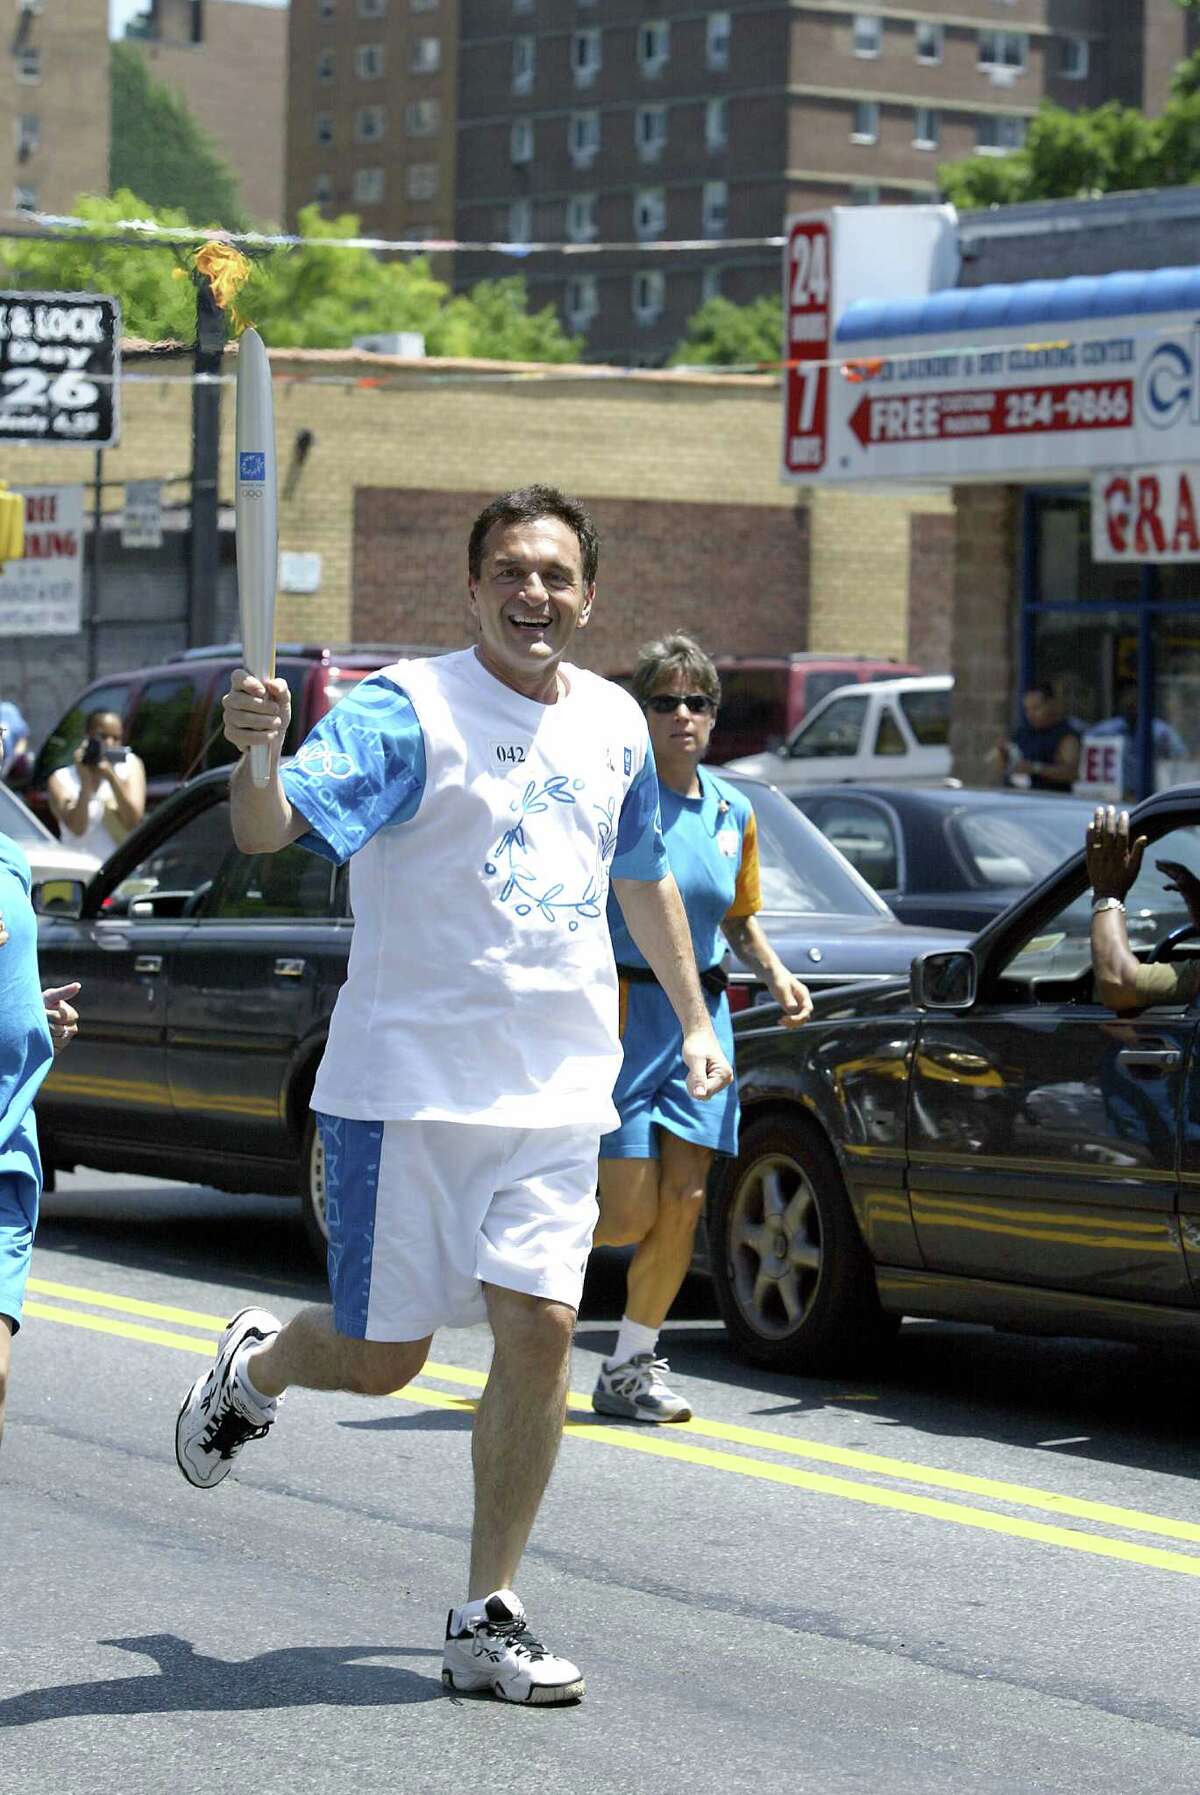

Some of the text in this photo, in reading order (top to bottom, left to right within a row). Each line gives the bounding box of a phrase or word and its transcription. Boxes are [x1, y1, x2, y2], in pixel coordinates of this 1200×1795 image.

[790, 232, 827, 306] 24
[797, 362, 820, 434] 7
[871, 396, 940, 442] FREE
[1004, 386, 1130, 429] 254-9866
[496, 745, 526, 763] 042
